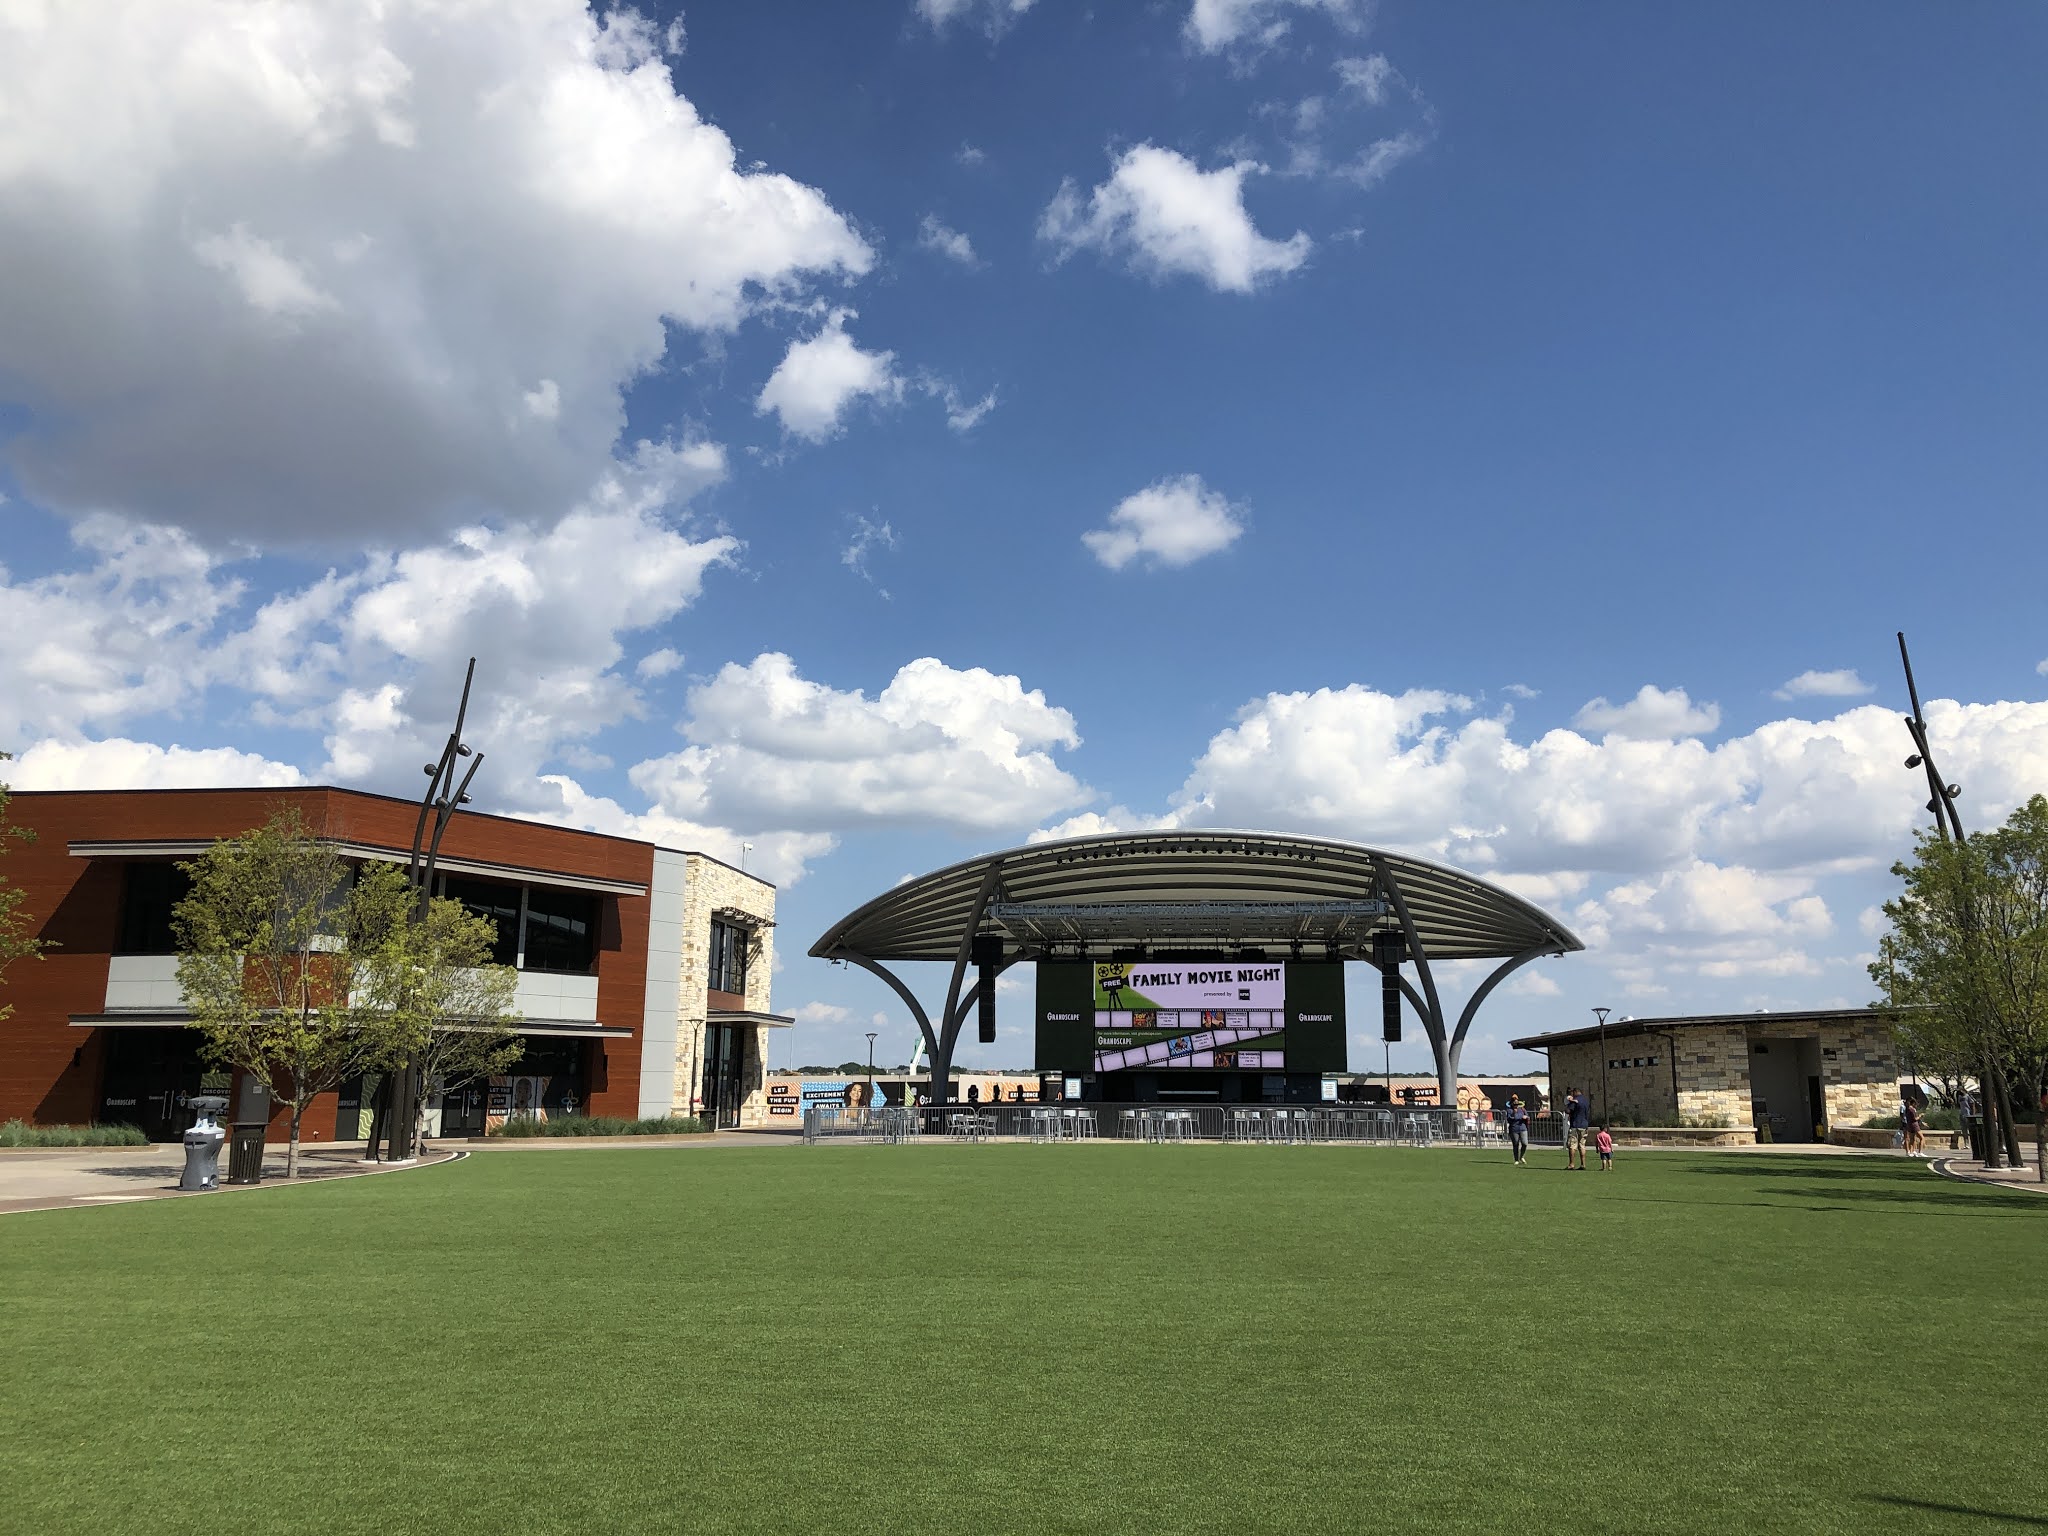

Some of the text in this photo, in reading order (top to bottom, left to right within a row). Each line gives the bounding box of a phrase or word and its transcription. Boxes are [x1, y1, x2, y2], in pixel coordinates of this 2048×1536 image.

[1132, 968, 1281, 987] FAMILY MOVIE NIGHT
[1103, 979, 1122, 988] FREE
[806, 1091, 846, 1099] EXCITEMENT
